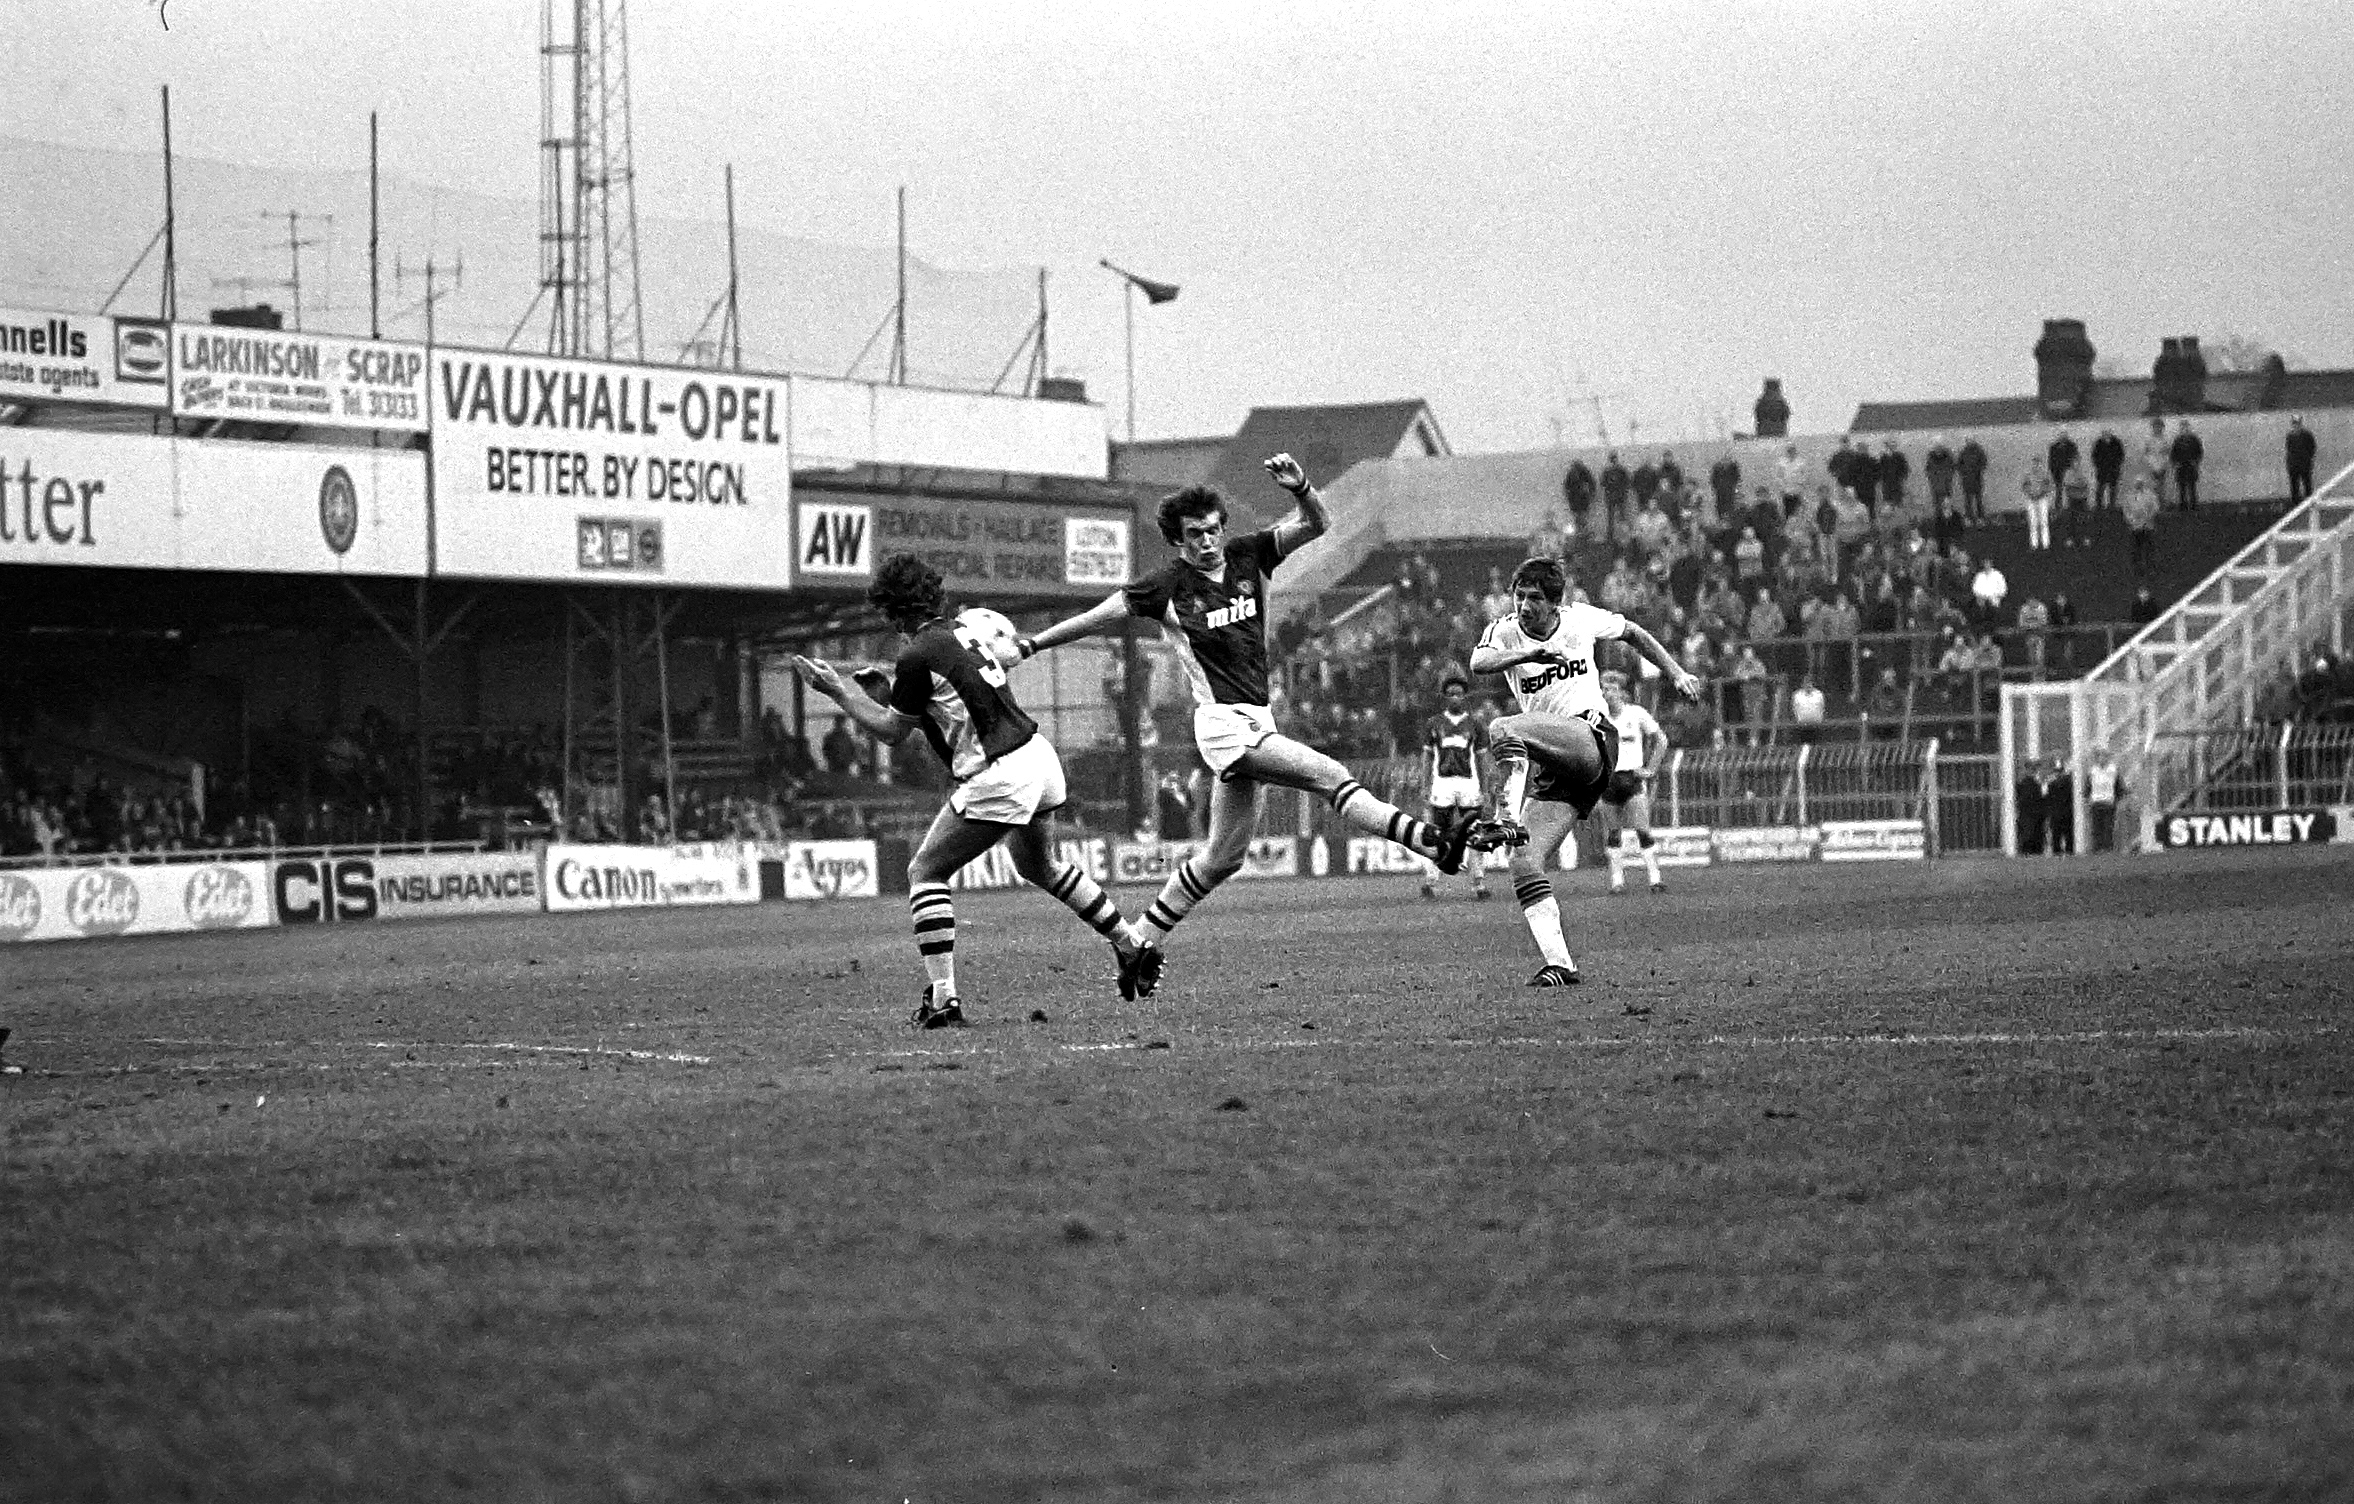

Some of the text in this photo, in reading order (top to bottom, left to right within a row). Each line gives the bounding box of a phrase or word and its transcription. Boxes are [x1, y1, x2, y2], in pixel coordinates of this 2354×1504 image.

[0, 361, 99, 394] tate agents
[180, 333, 320, 381] LARKINSON
[347, 348, 422, 388] SCRAP
[442, 360, 780, 444] VAUXHALL-OPEL
[602, 454, 639, 499] BY
[0, 456, 104, 546] tter
[804, 511, 866, 567] AW
[1206, 595, 1257, 629] mita
[2168, 812, 2316, 847] STANLEY
[554, 857, 657, 901] Canon
[1121, 845, 1196, 877] adid
[274, 860, 536, 922] CIS INSURANCE
